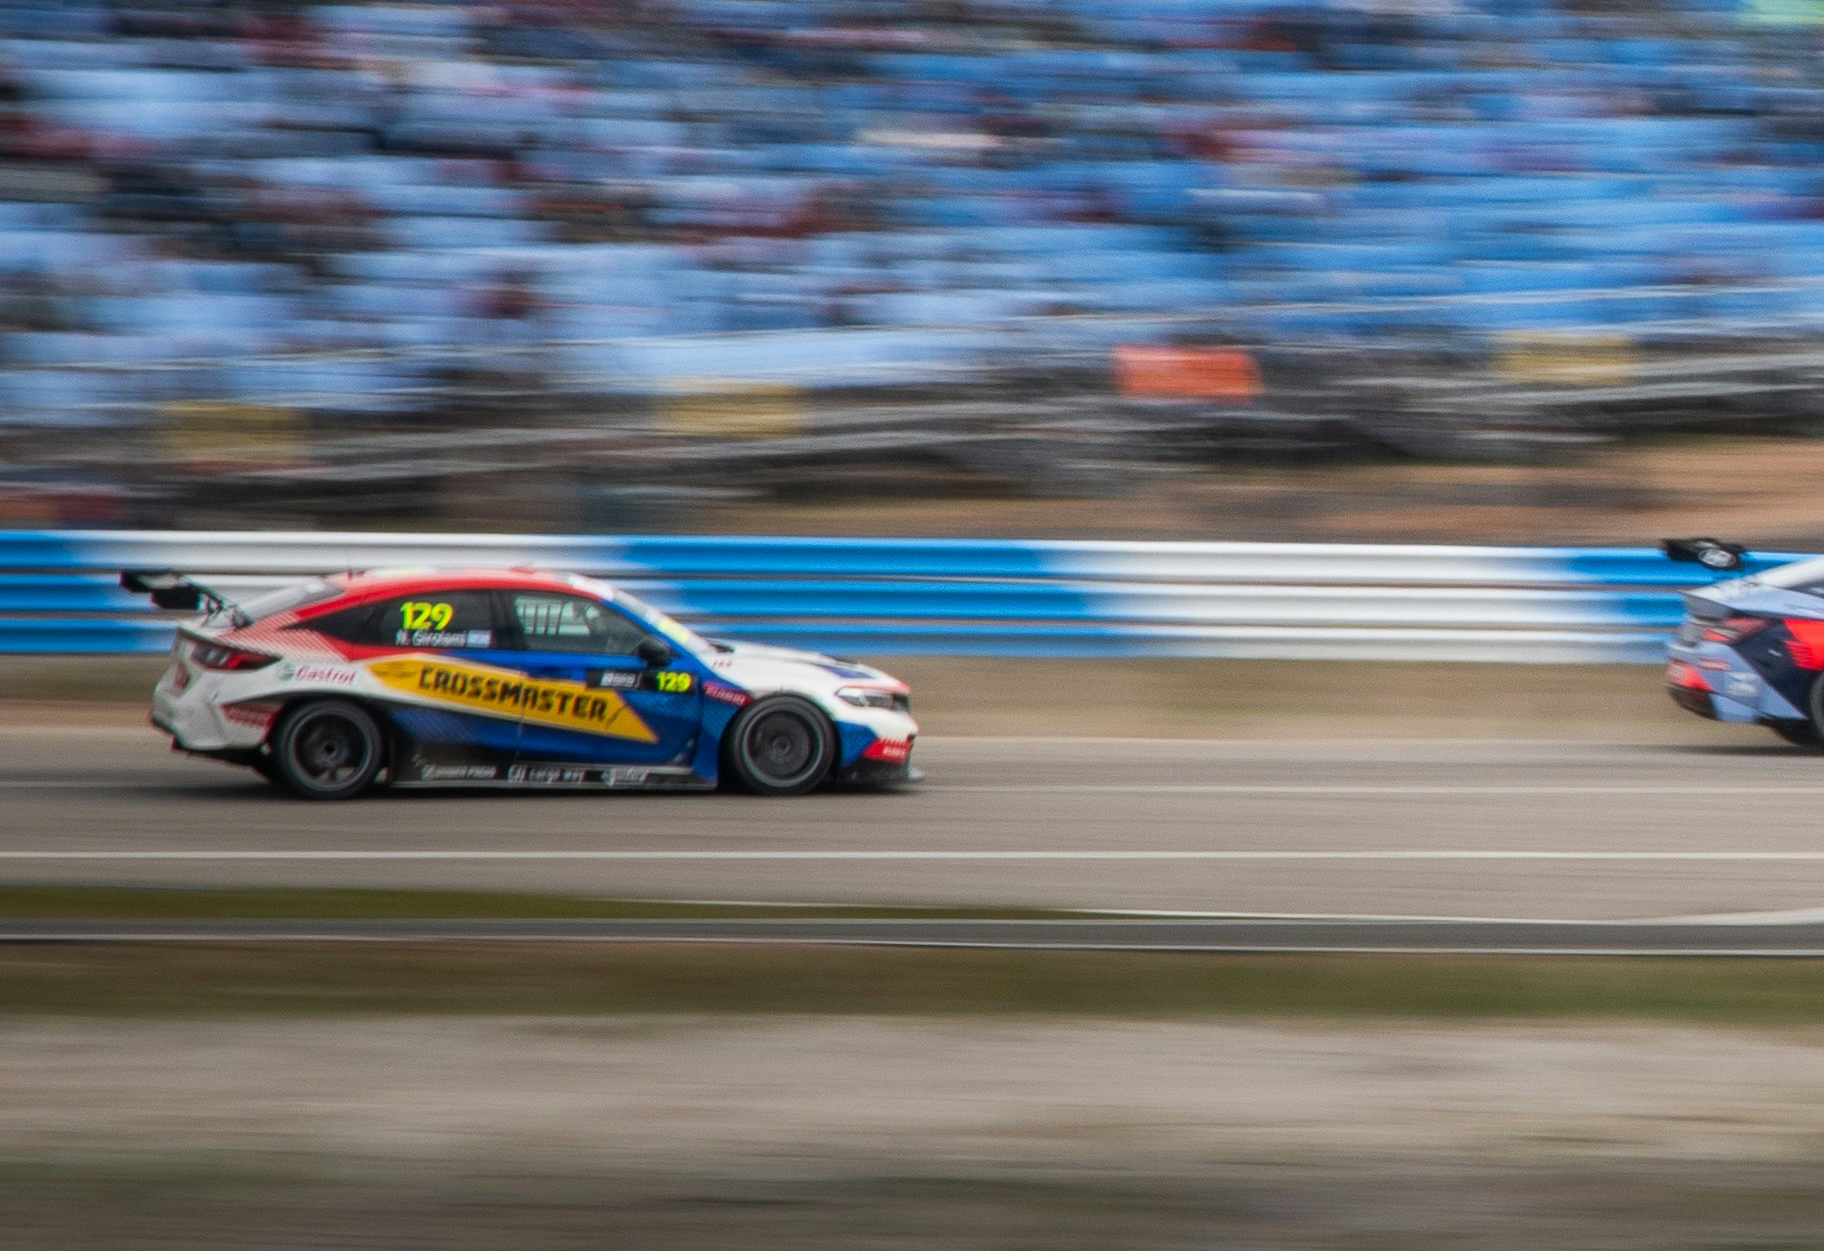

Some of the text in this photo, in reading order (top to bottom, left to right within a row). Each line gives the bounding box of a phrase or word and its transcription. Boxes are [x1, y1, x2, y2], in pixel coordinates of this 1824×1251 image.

[400, 602, 453, 630] 129
[296, 665, 357, 685] Castrol
[656, 671, 692, 693] 129
[418, 666, 609, 721] CROSSMASTER
